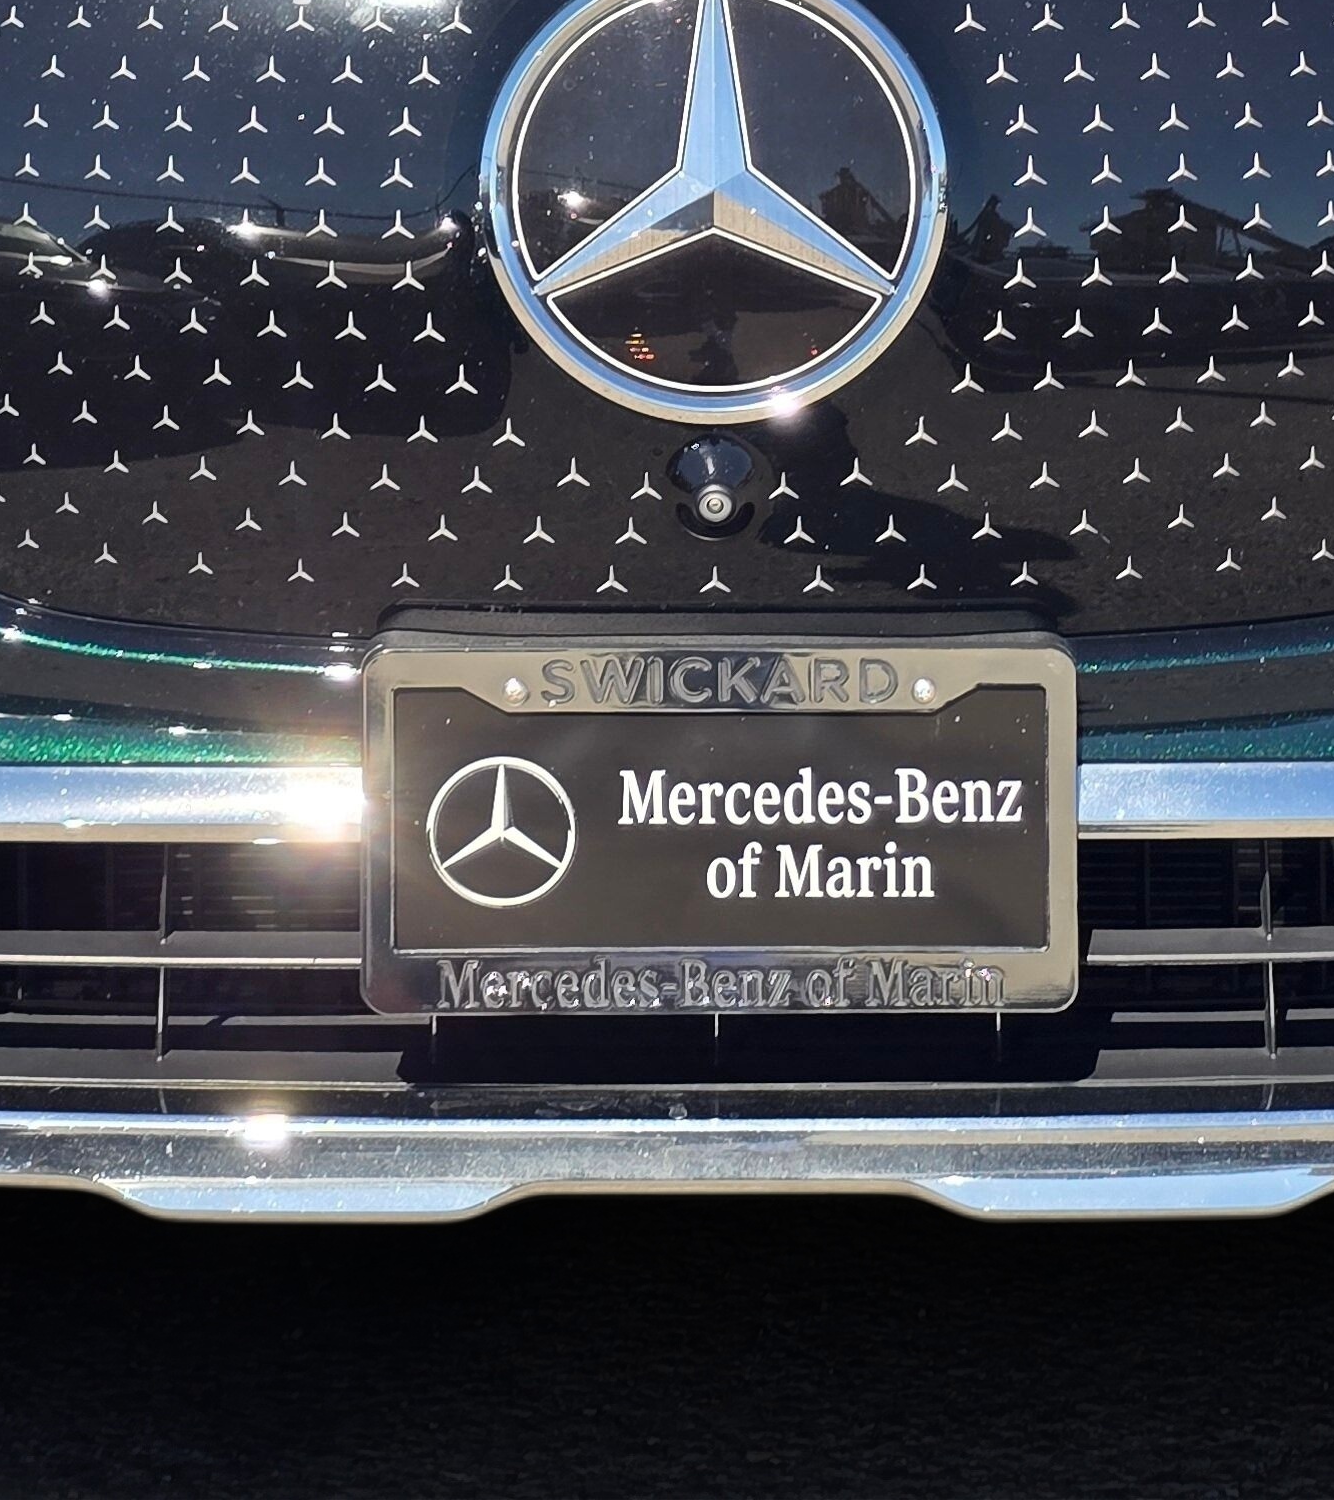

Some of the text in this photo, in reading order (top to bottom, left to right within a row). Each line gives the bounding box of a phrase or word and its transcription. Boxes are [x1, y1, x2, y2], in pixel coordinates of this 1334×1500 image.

[540, 655, 899, 704] SWICKARD
[618, 766, 1025, 826] Mercedes-Benz
[705, 842, 935, 899] of Marin
[436, 957, 1010, 1010] Mercedes-Benz of Marin
